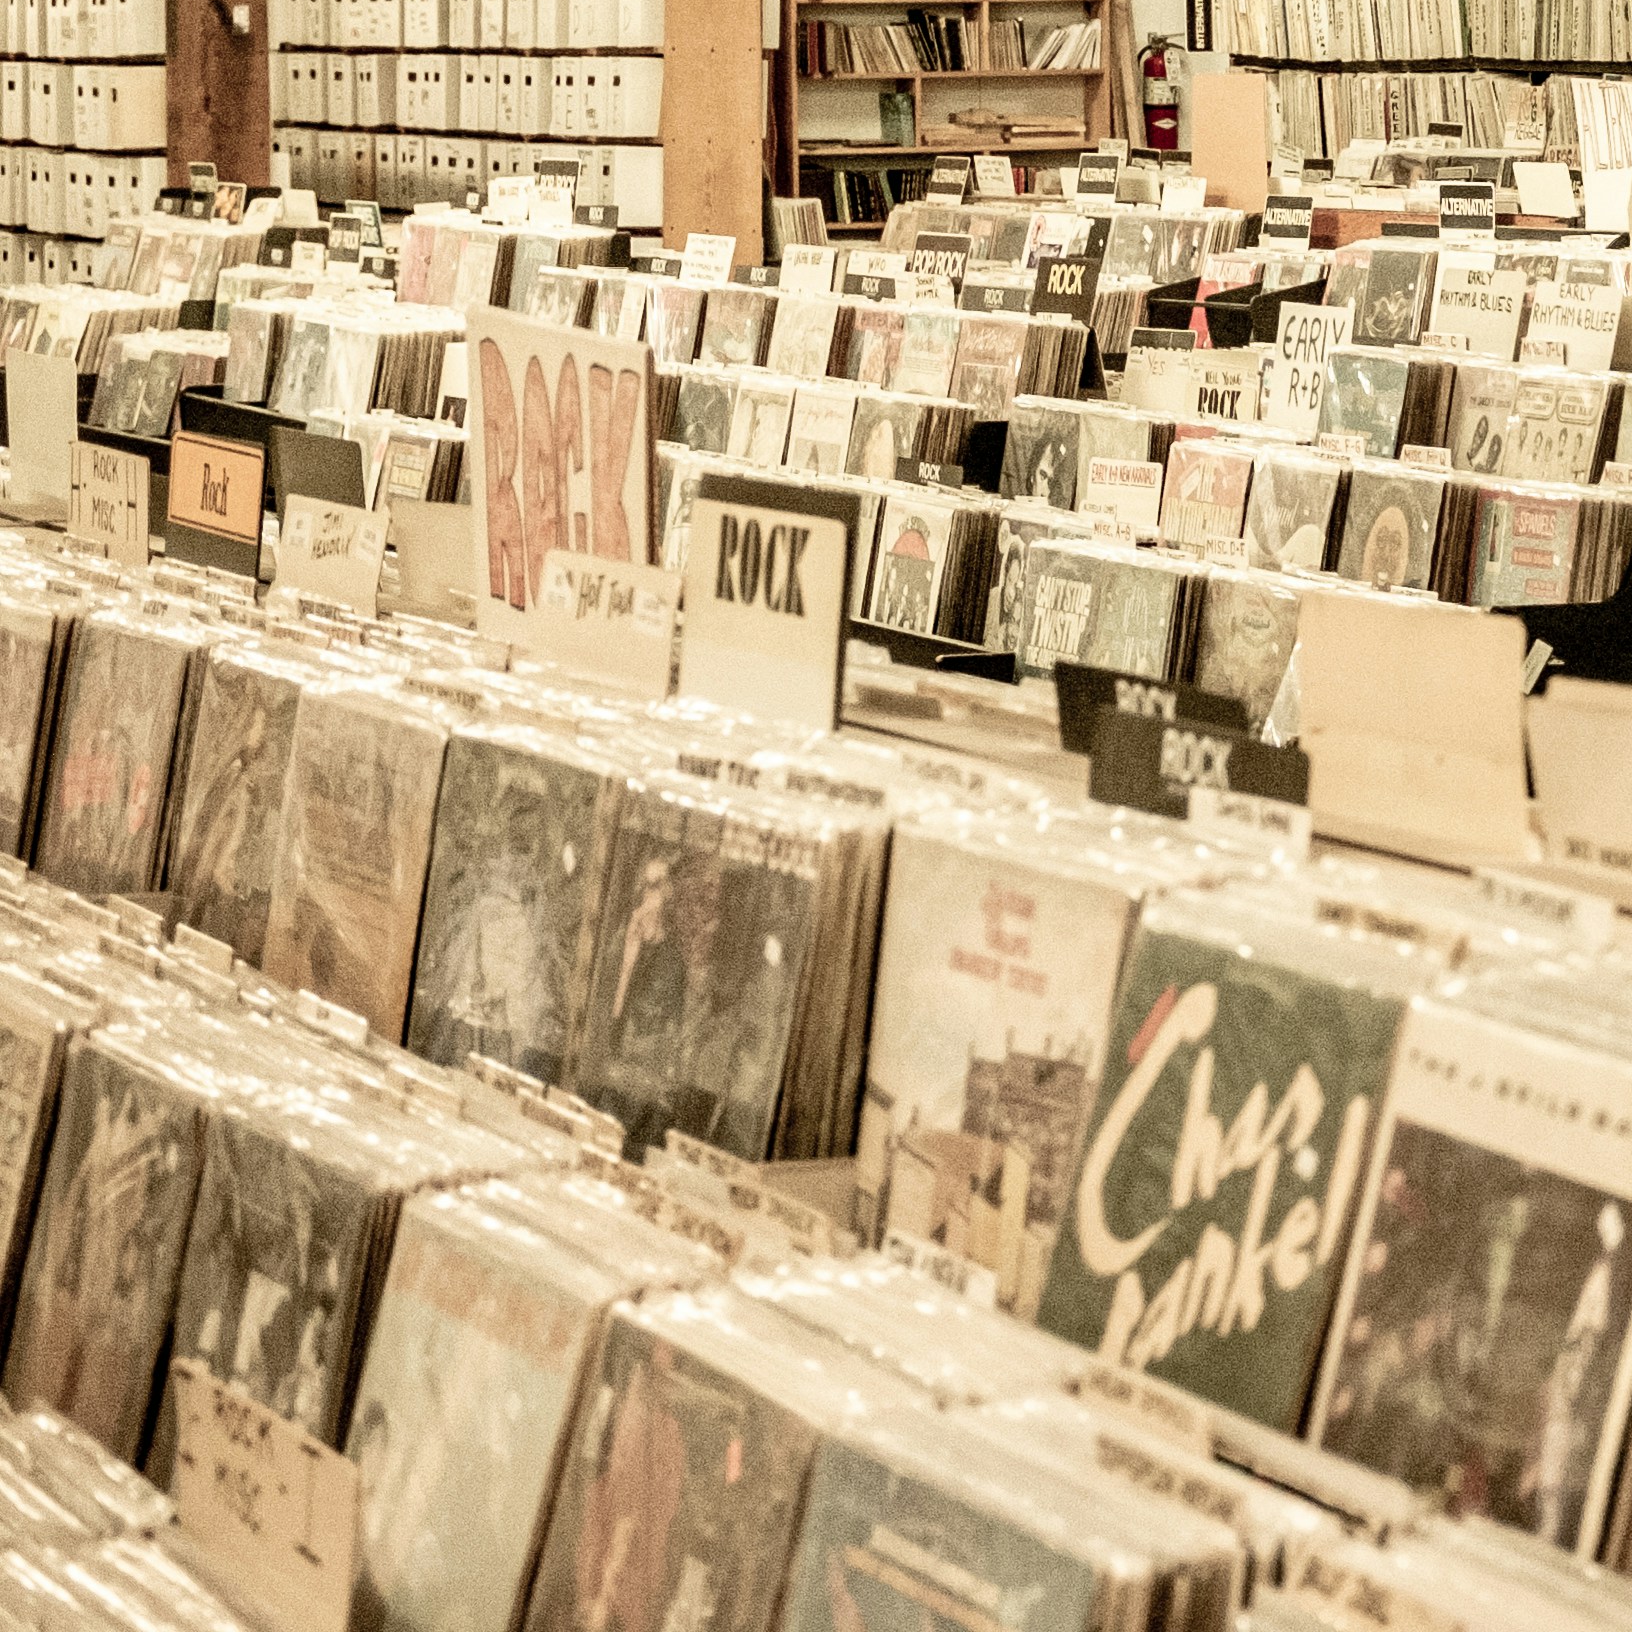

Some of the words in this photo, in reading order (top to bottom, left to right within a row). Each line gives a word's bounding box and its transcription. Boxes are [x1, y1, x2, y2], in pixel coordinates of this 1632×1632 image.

[1264, 208, 1312, 227] ALTERNATIVE
[1440, 197, 1494, 218] ALTERNATIVE
[1048, 264, 1086, 295] ROCK
[1467, 269, 1493, 286] EARLY
[984, 289, 1004, 306] ROCK
[1559, 283, 1594, 302] EARLY
[1199, 386, 1240, 420] ROCK
[93, 450, 118, 482] ROCK
[919, 462, 940, 481] ROCK
[715, 514, 809, 618] ROCK
